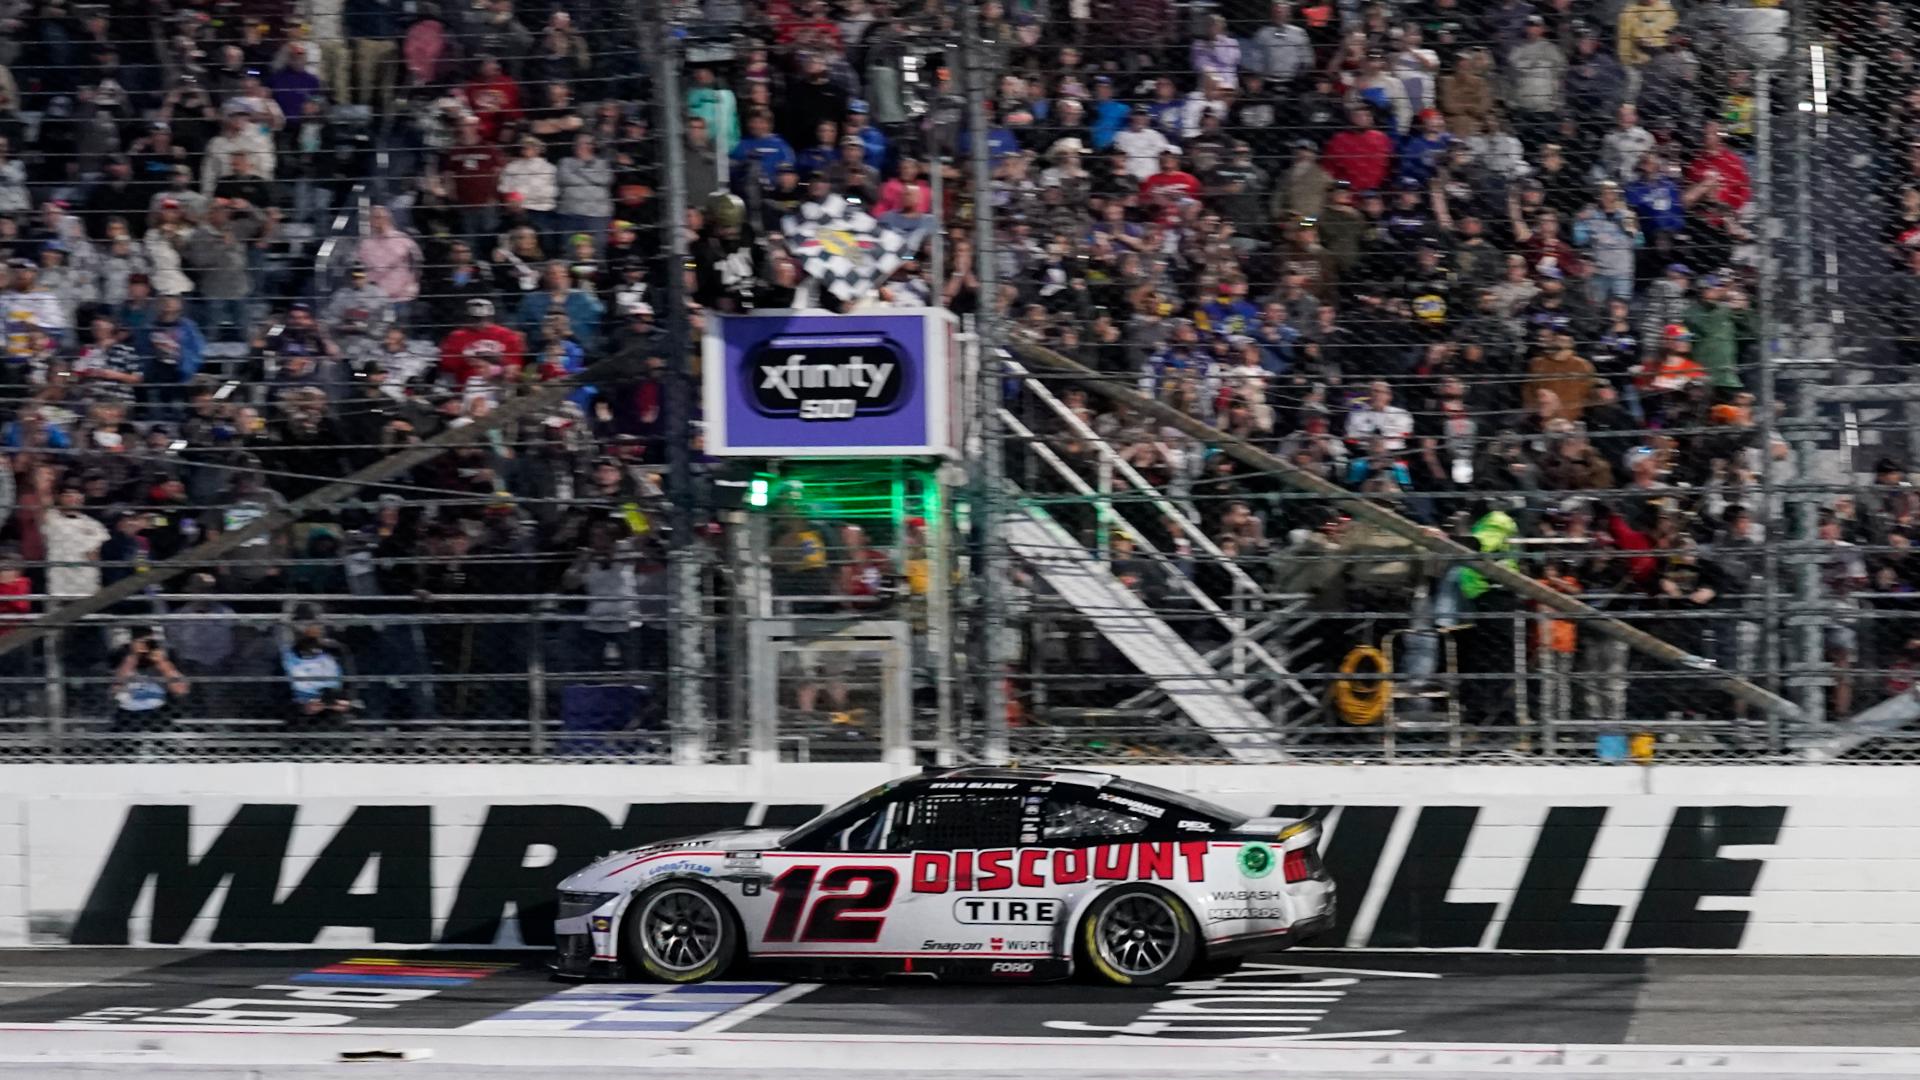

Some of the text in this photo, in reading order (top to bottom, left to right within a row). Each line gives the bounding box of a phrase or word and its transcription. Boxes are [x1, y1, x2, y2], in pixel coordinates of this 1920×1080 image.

[759, 354, 895, 400] xfinity
[799, 399, 857, 419] 500
[69, 802, 1789, 951] MARILLE
[911, 841, 1209, 894] DISCOUNT
[762, 864, 899, 943] 12
[1212, 890, 1280, 901] WABASH
[966, 900, 1055, 922] TIRE
[921, 939, 984, 952] Snap-on
[991, 962, 1034, 973] FORD
